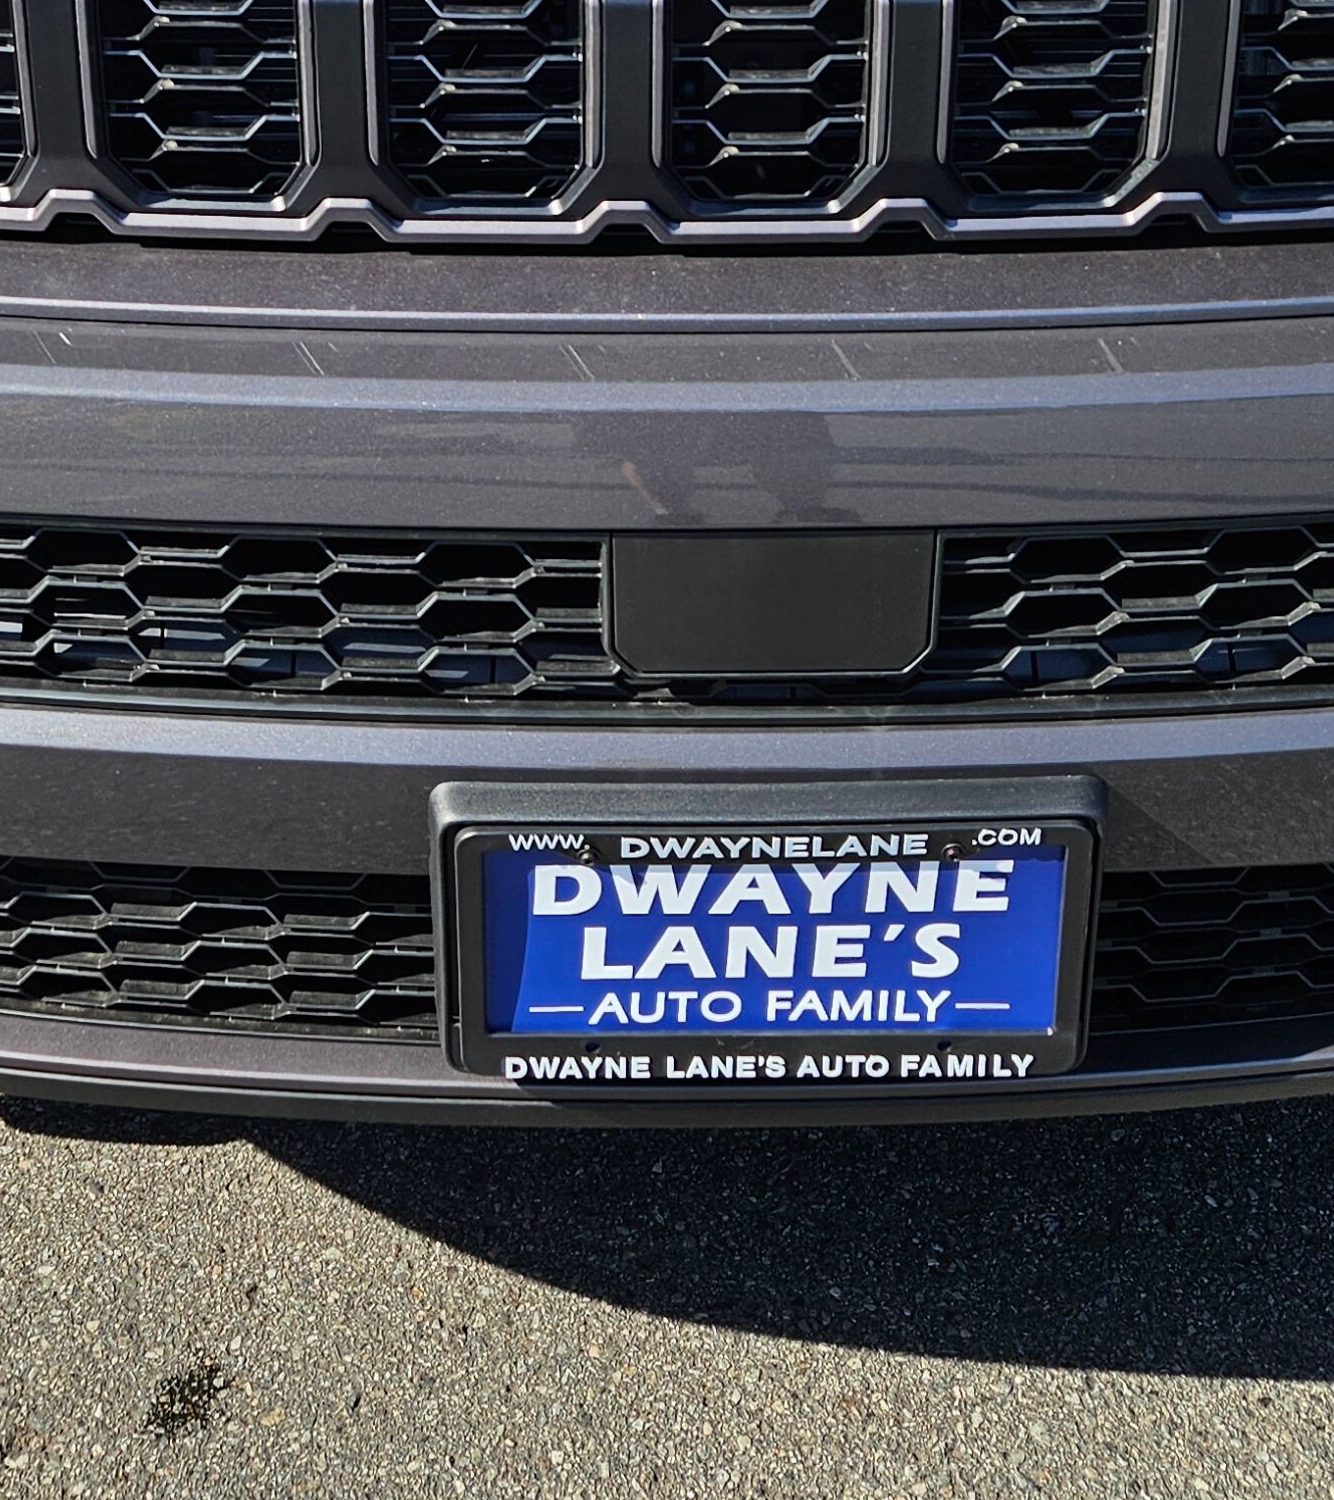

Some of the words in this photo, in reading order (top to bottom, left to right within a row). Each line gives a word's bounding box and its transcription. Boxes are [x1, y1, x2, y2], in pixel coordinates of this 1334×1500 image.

[620, 833, 929, 859] DWAYNELANE
[971, 827, 1042, 846] .COM
[532, 860, 1014, 916] DWAYNE
[581, 923, 960, 980] LANE'S
[587, 990, 743, 1025] AUTO
[766, 989, 952, 1022] FAMILY
[504, 1055, 651, 1079] DWAYNE
[666, 1055, 786, 1079] LANE'S
[796, 1054, 890, 1078] AUTO
[900, 1053, 1034, 1078] FAMILY
